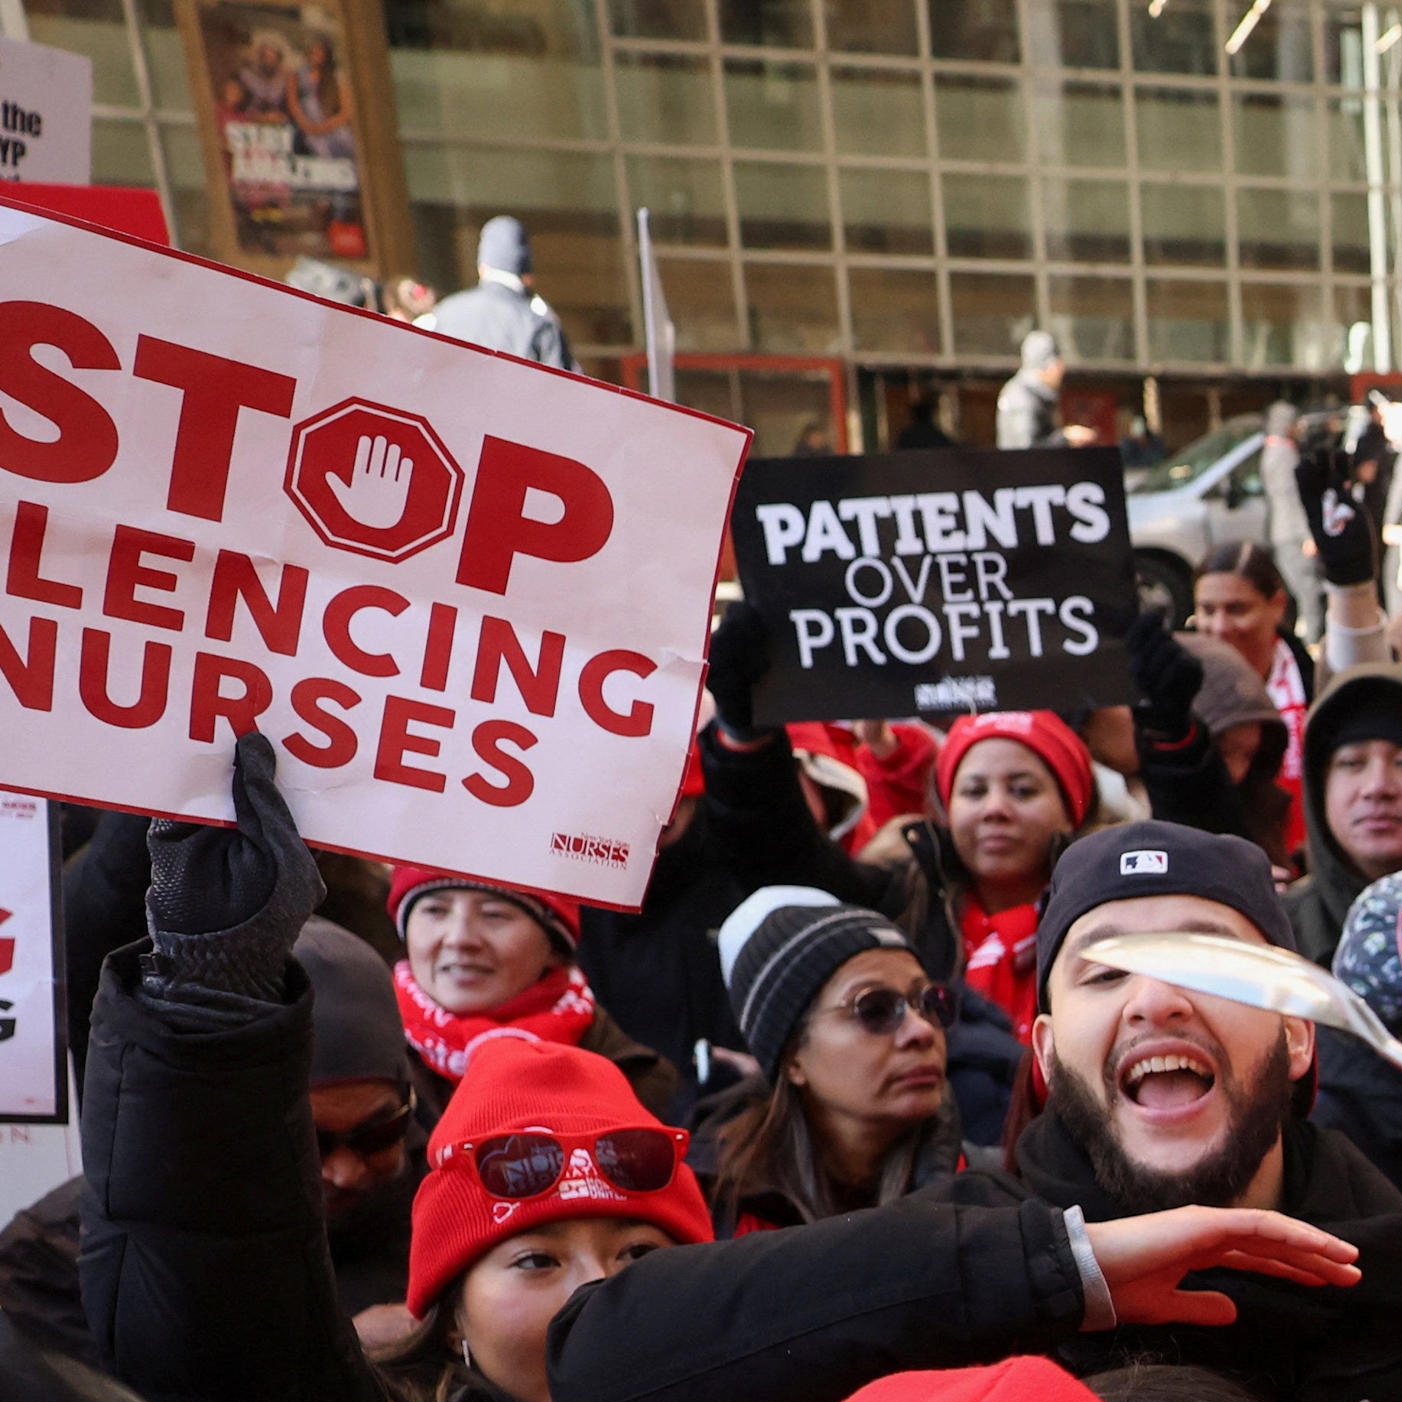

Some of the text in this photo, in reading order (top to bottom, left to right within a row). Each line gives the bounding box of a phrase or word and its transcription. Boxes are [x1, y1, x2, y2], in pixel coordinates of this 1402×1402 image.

[756, 482, 1111, 566] PATIENTS
[844, 552, 1014, 608] OVER
[789, 596, 1101, 669] PROFITS
[0, 615, 539, 808] NURSES
[550, 831, 630, 864] NURSES
